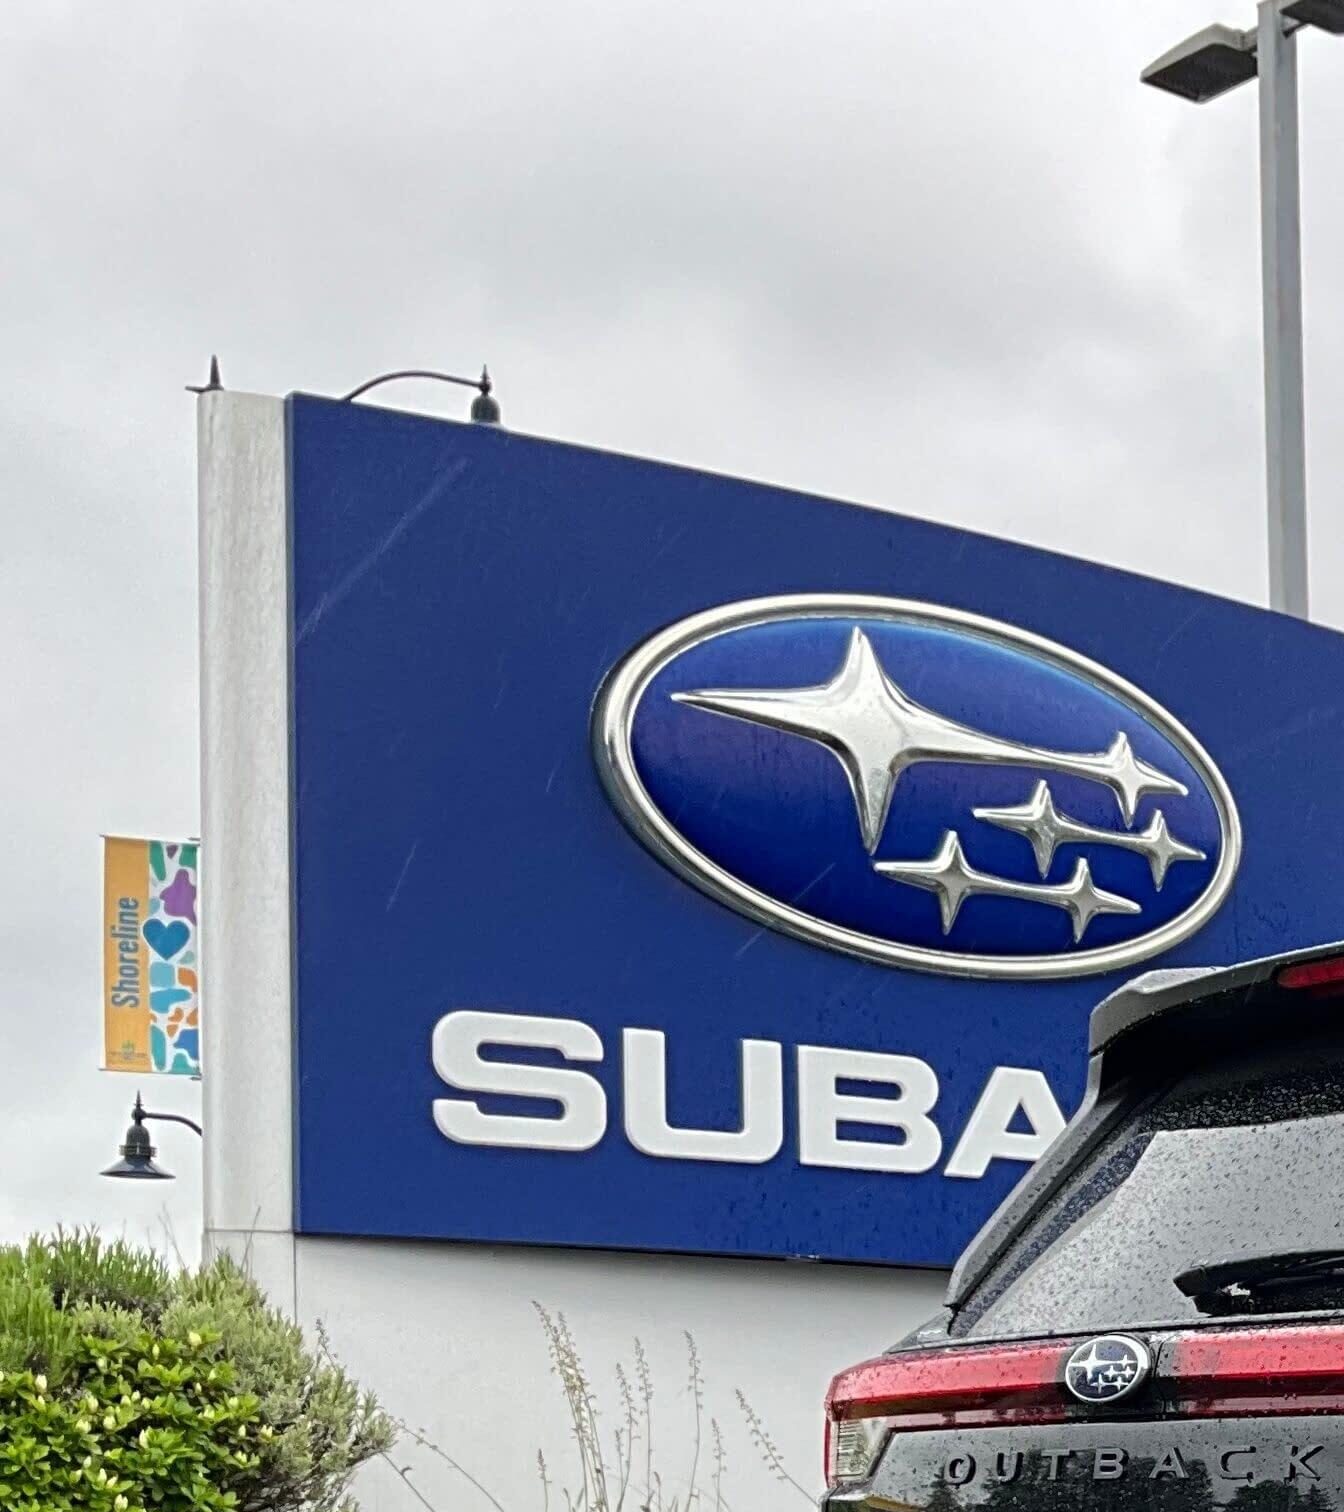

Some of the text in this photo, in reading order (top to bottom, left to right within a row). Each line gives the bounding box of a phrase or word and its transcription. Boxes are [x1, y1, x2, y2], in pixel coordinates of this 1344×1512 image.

[111, 896, 140, 1008] Shoreline
[431, 1009, 1068, 1178] SUBA
[943, 1445, 1325, 1487] OUTBACK
